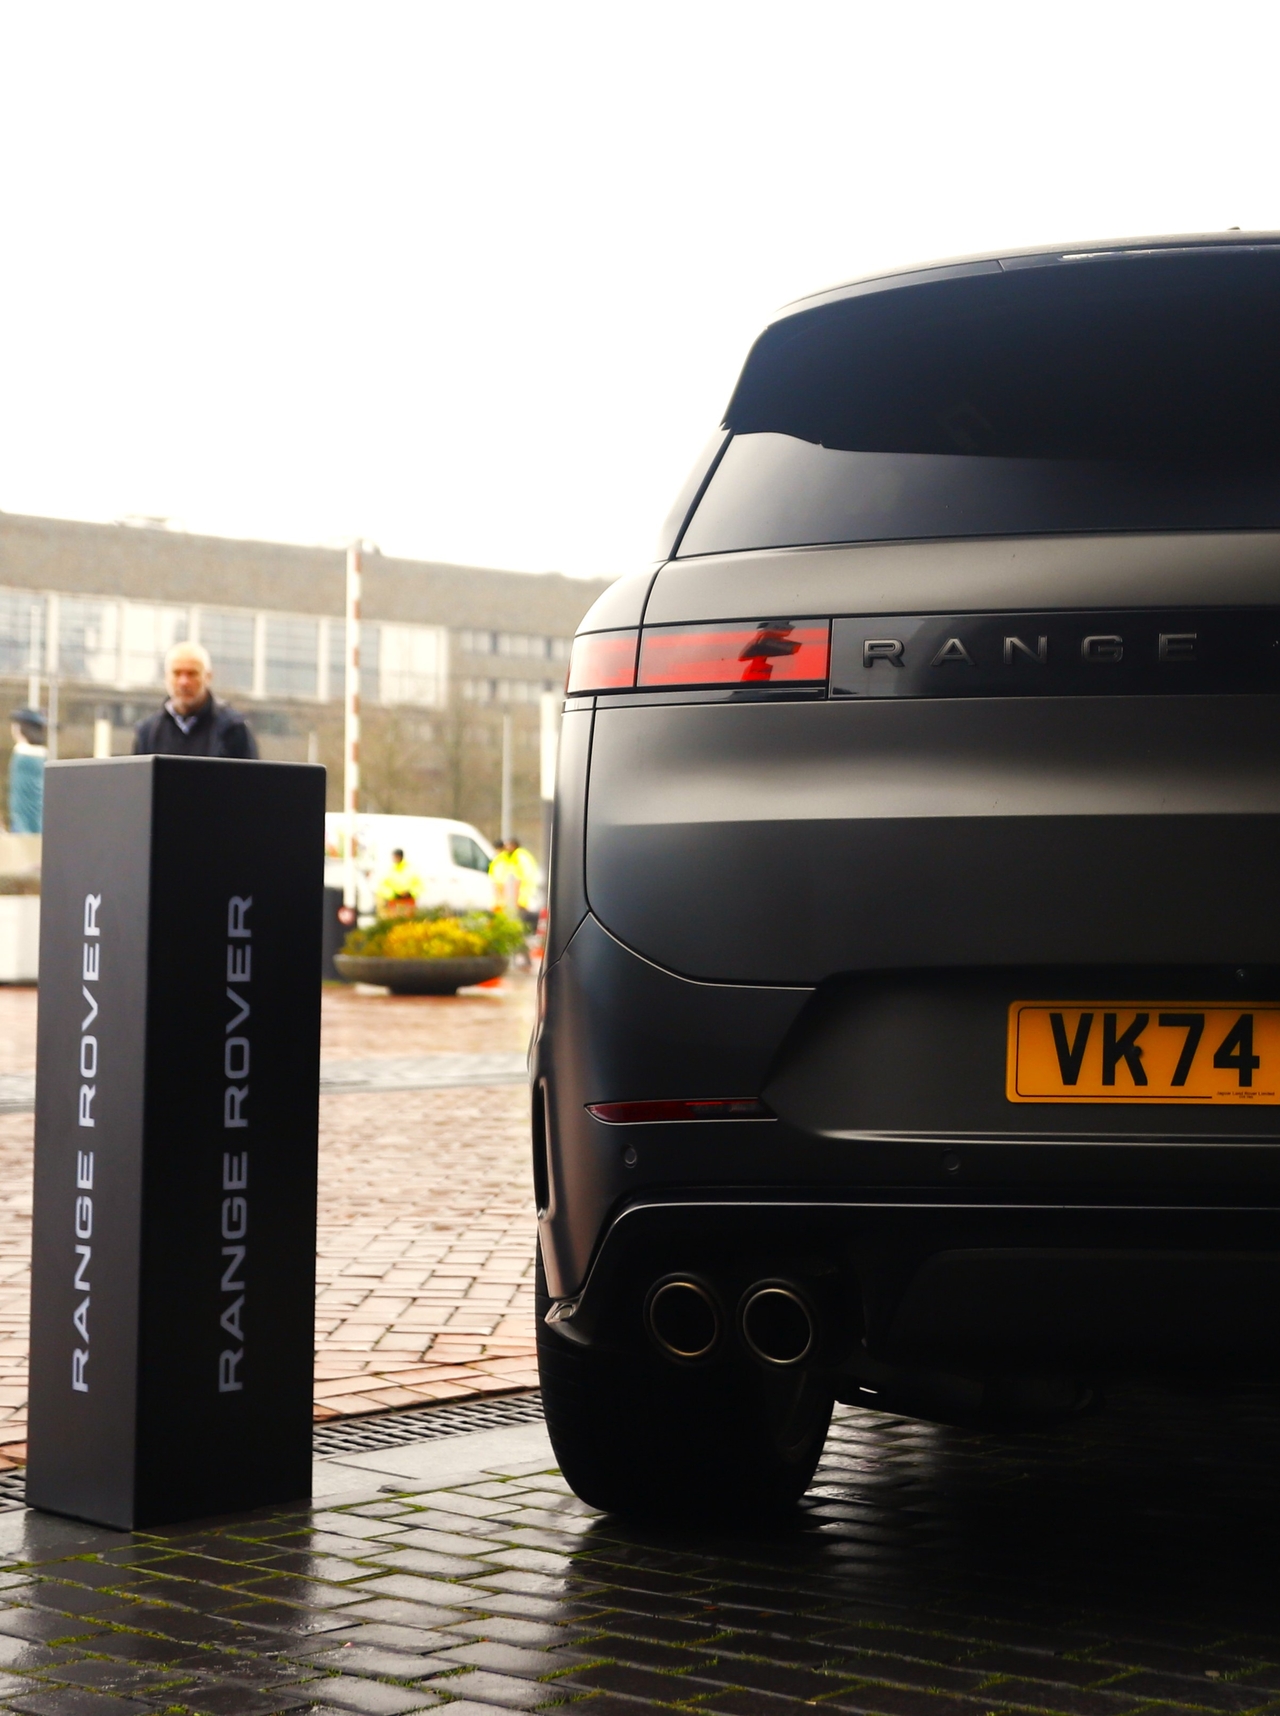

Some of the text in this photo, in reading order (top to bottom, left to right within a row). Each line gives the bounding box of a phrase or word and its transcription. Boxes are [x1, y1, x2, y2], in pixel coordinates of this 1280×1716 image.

[862, 632, 1198, 668] RANGE
[71, 892, 103, 1394] RANGE ROVER
[218, 894, 255, 1394] RANGE ROVER
[1049, 1012, 1261, 1088] VK74
